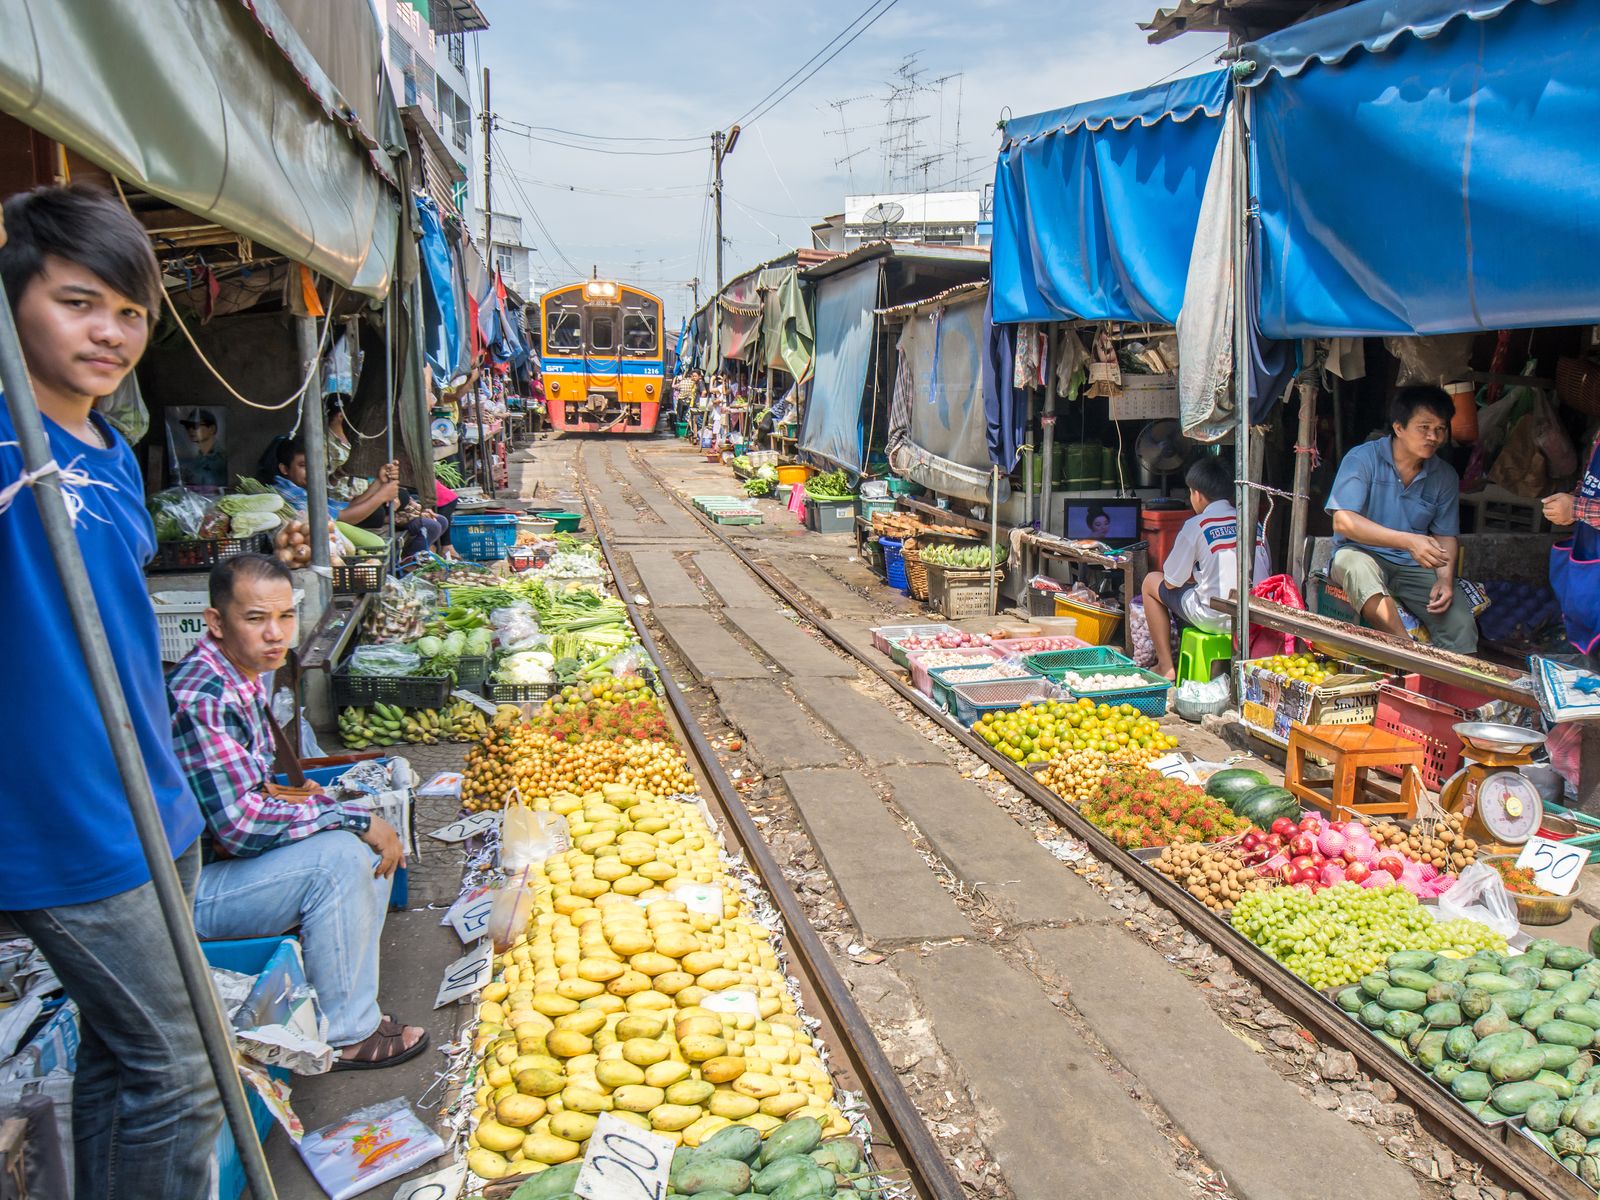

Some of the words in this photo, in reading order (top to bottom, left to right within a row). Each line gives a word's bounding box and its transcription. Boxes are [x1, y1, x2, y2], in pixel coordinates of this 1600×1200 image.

[447, 815, 495, 838] 25
[1534, 843, 1581, 879] 50
[443, 958, 489, 992] 40
[592, 1133, 661, 1200] 20
